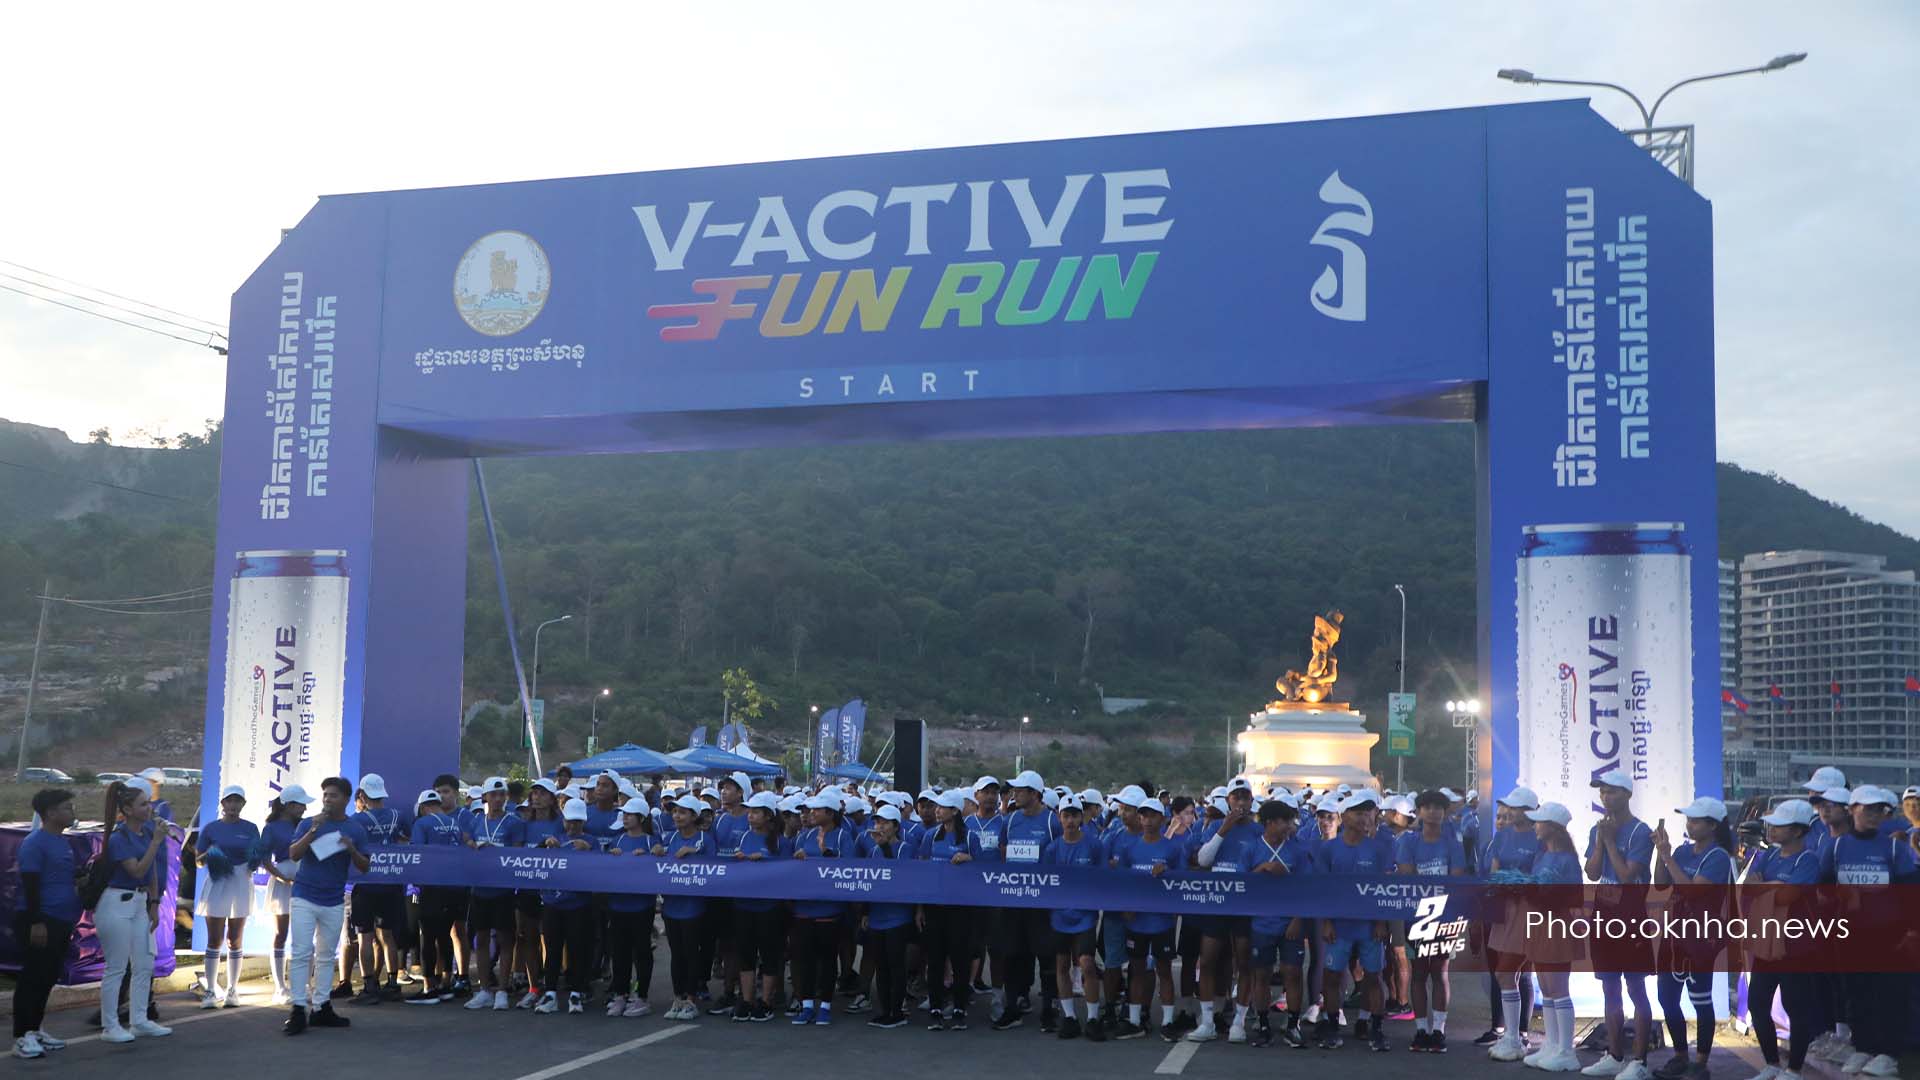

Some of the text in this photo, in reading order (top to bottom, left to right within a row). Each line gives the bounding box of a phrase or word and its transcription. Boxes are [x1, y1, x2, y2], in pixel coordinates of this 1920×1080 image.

[632, 168, 1175, 272] V-ACTIVE
[647, 251, 1160, 342] FUN RUN
[799, 370, 979, 399] START
[1588, 615, 1620, 815] ACTIVE
[249, 681, 261, 769] #BeyondTheGames
[1559, 682, 1570, 788] #BeyondTheGames
[369, 852, 421, 864] ACTIVE
[1013, 847, 1032, 856] V4-1
[500, 856, 568, 870] V-ACTIVE
[656, 862, 727, 876] V-ACTIVE
[818, 867, 892, 880] V-ACTIVE
[982, 872, 1061, 886] V-ACTIVE
[1846, 874, 1880, 884] V10-2
[1162, 879, 1246, 892] V-ACTIVE
[1356, 883, 1446, 897] V-ACTIVE
